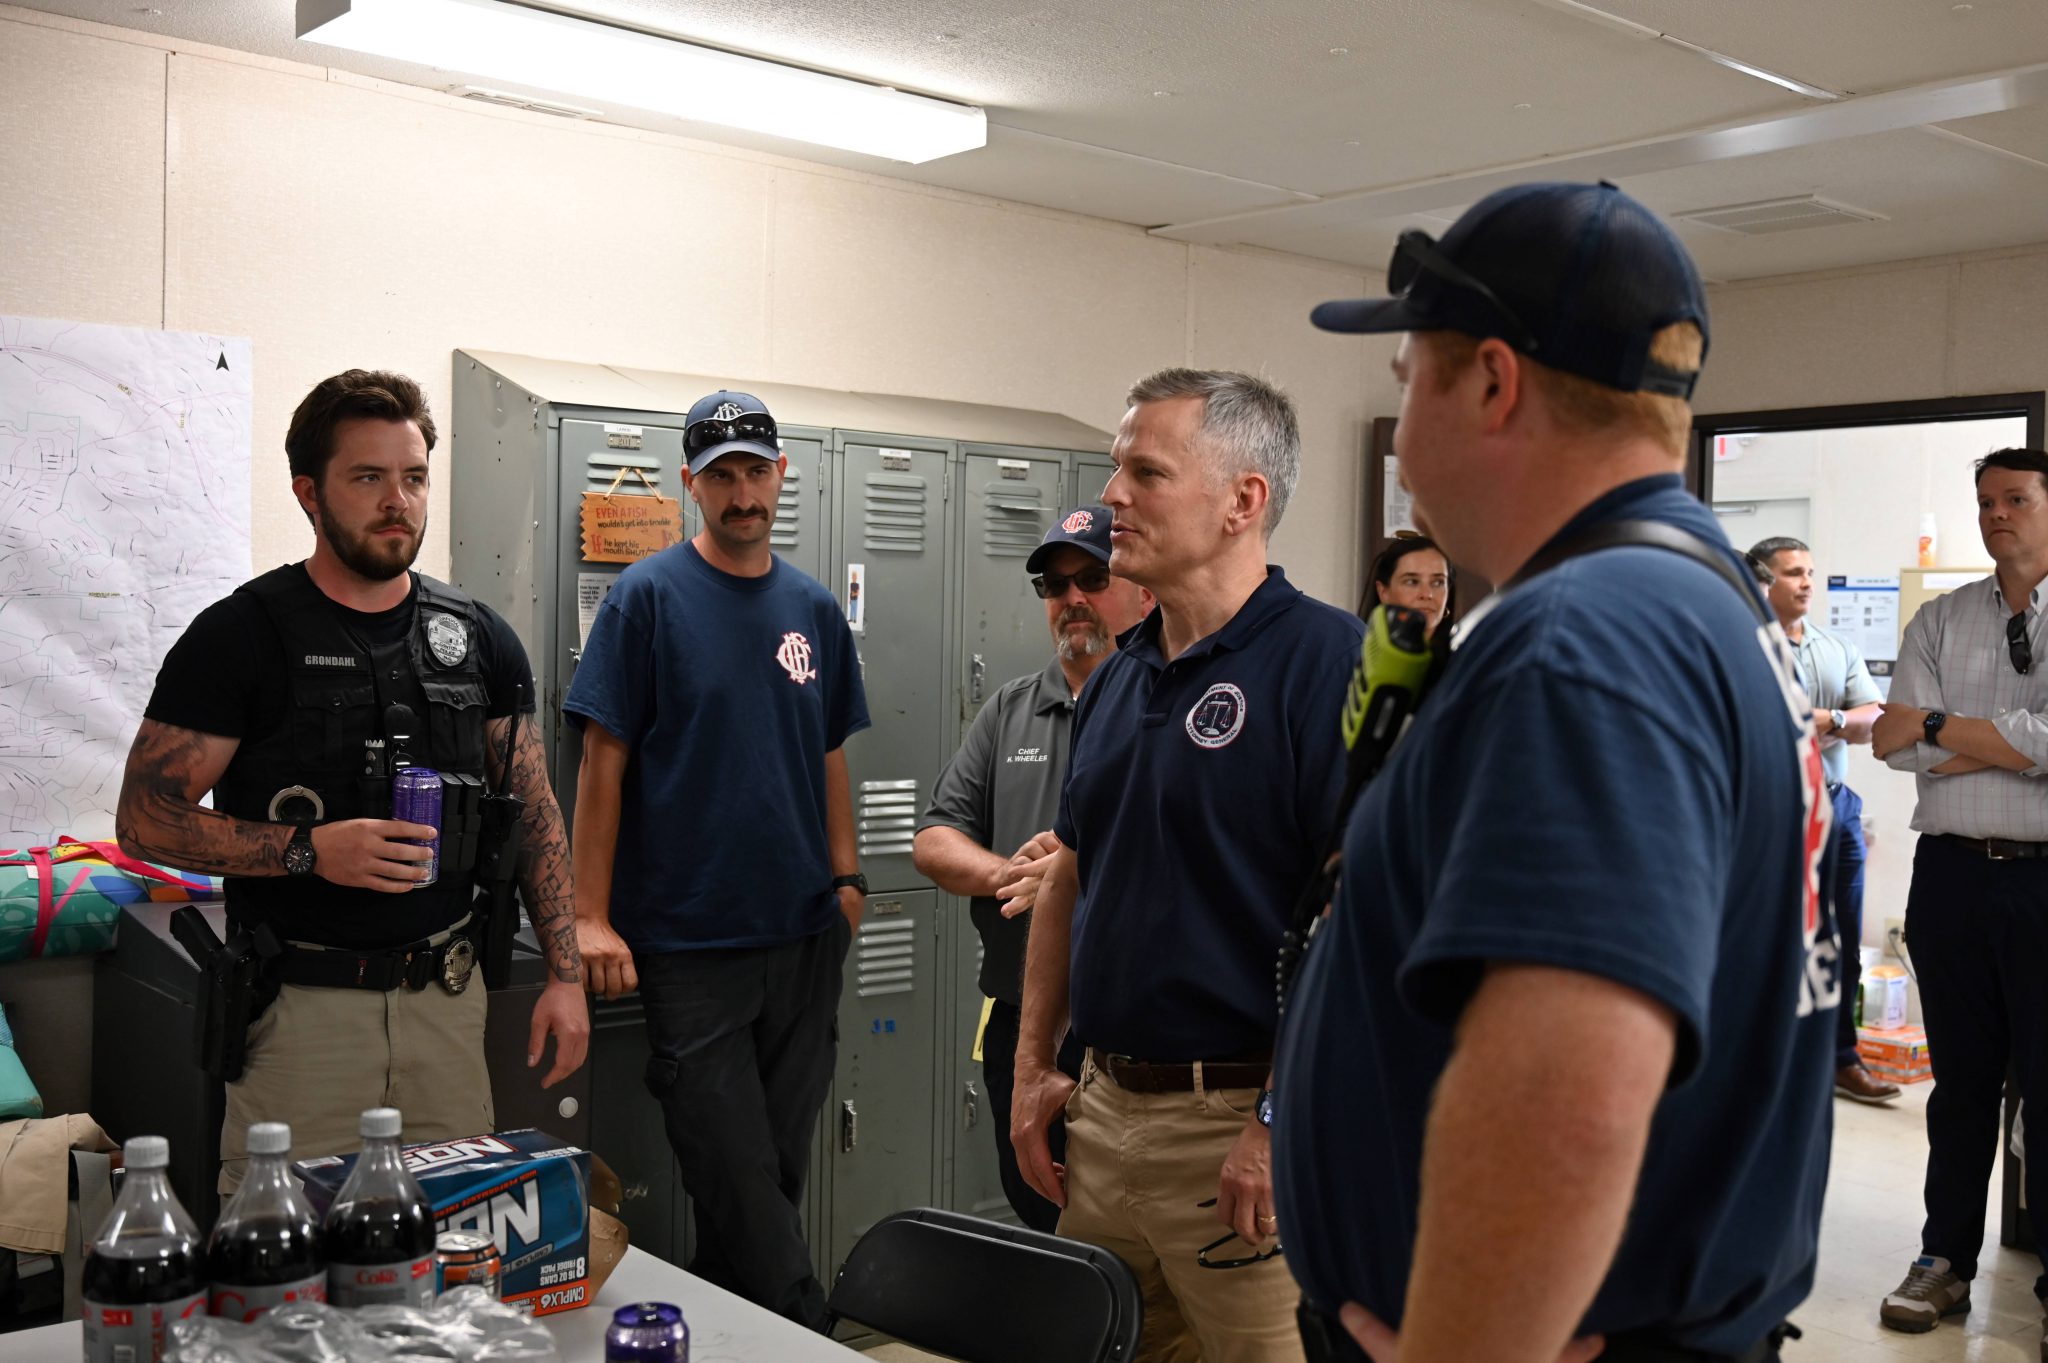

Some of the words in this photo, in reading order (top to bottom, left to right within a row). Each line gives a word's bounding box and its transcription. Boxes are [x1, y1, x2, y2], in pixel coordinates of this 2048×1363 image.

[596, 508, 619, 519] EVEN
[620, 507, 627, 518] A
[629, 506, 647, 519] FISH
[625, 521, 636, 530] get
[604, 538, 613, 546] he
[614, 538, 628, 549] kept
[603, 547, 624, 555] mouth
[305, 655, 357, 667] GRONDAHL
[1187, 723, 1208, 744] ATTORNEY
[1210, 729, 1238, 744] GENERAL
[461, 1177, 518, 1206] PERFORMANCE
[540, 1262, 556, 1274] PACK
[557, 1259, 576, 1270] FRIDGE
[576, 1256, 586, 1278] 8
[355, 1269, 399, 1285] Coke
[540, 1274, 558, 1286] CANS
[559, 1272, 568, 1282] OZ
[568, 1270, 576, 1281] 16
